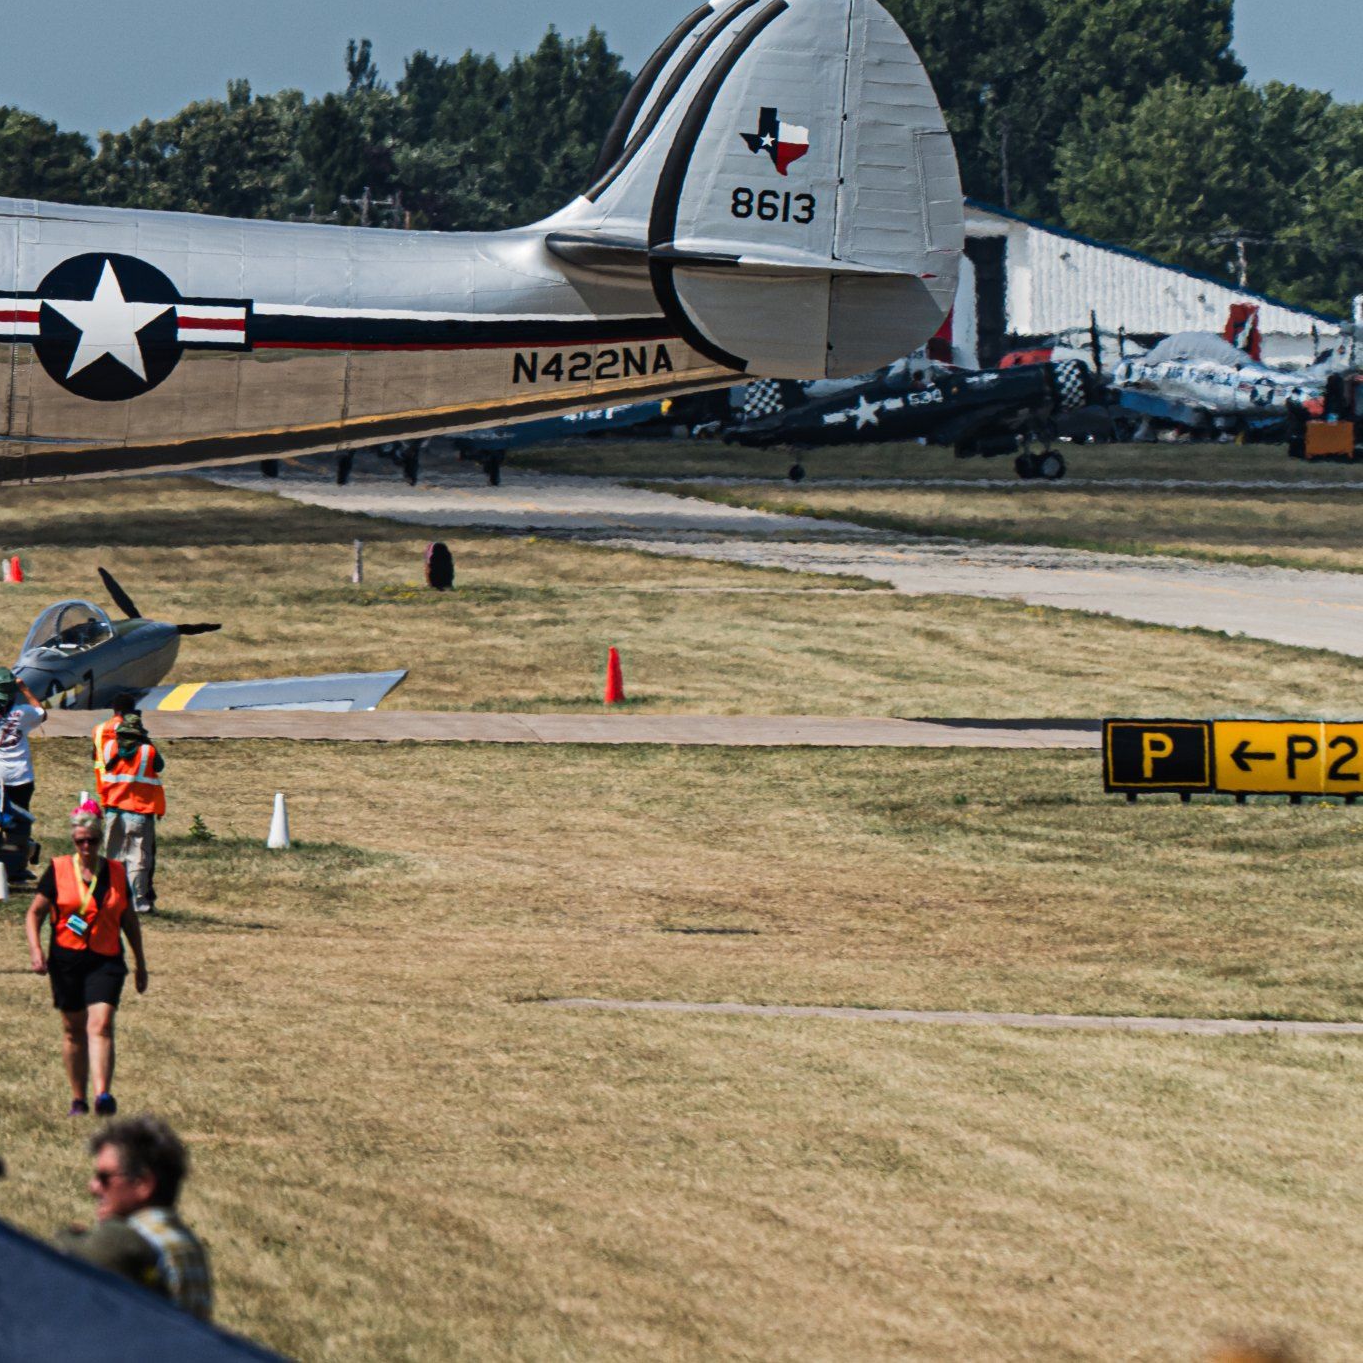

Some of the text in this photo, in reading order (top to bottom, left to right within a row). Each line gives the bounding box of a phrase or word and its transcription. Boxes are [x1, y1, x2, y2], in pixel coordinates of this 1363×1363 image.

[731, 185, 816, 225] 8613
[512, 343, 674, 385] N422NA
[1141, 731, 1175, 779] P
[1286, 734, 1362, 782] P2
